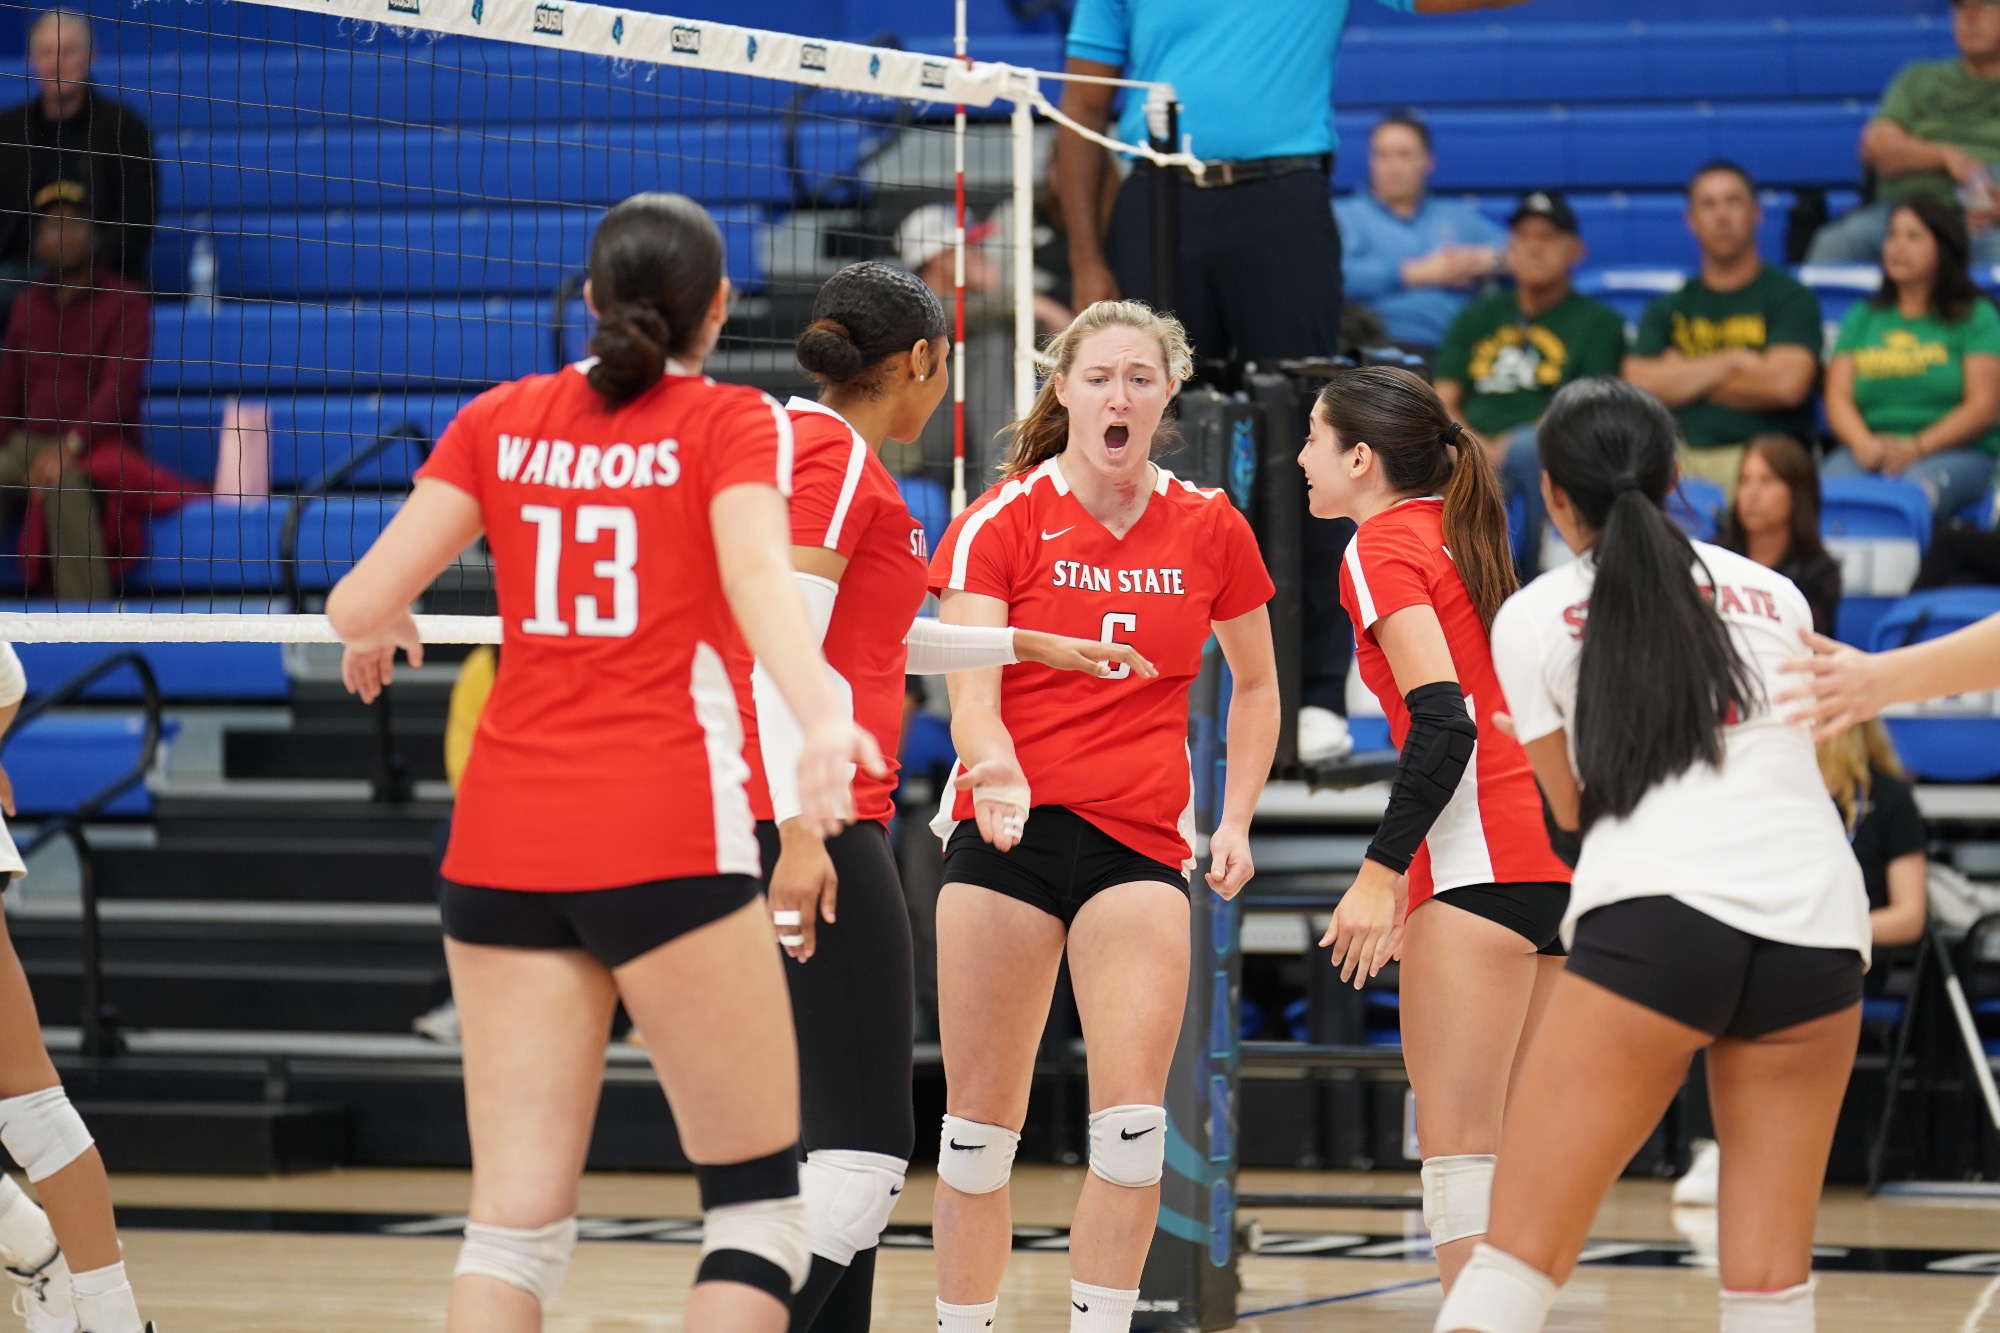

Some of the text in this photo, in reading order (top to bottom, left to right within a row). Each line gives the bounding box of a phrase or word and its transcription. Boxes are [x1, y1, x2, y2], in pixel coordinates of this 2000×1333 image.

[498, 434, 681, 490] WARRORS
[521, 504, 639, 637] 13
[1052, 560, 1185, 595] STAN STATE
[1696, 585, 1781, 623] TATE
[1099, 611, 1137, 680] 6
